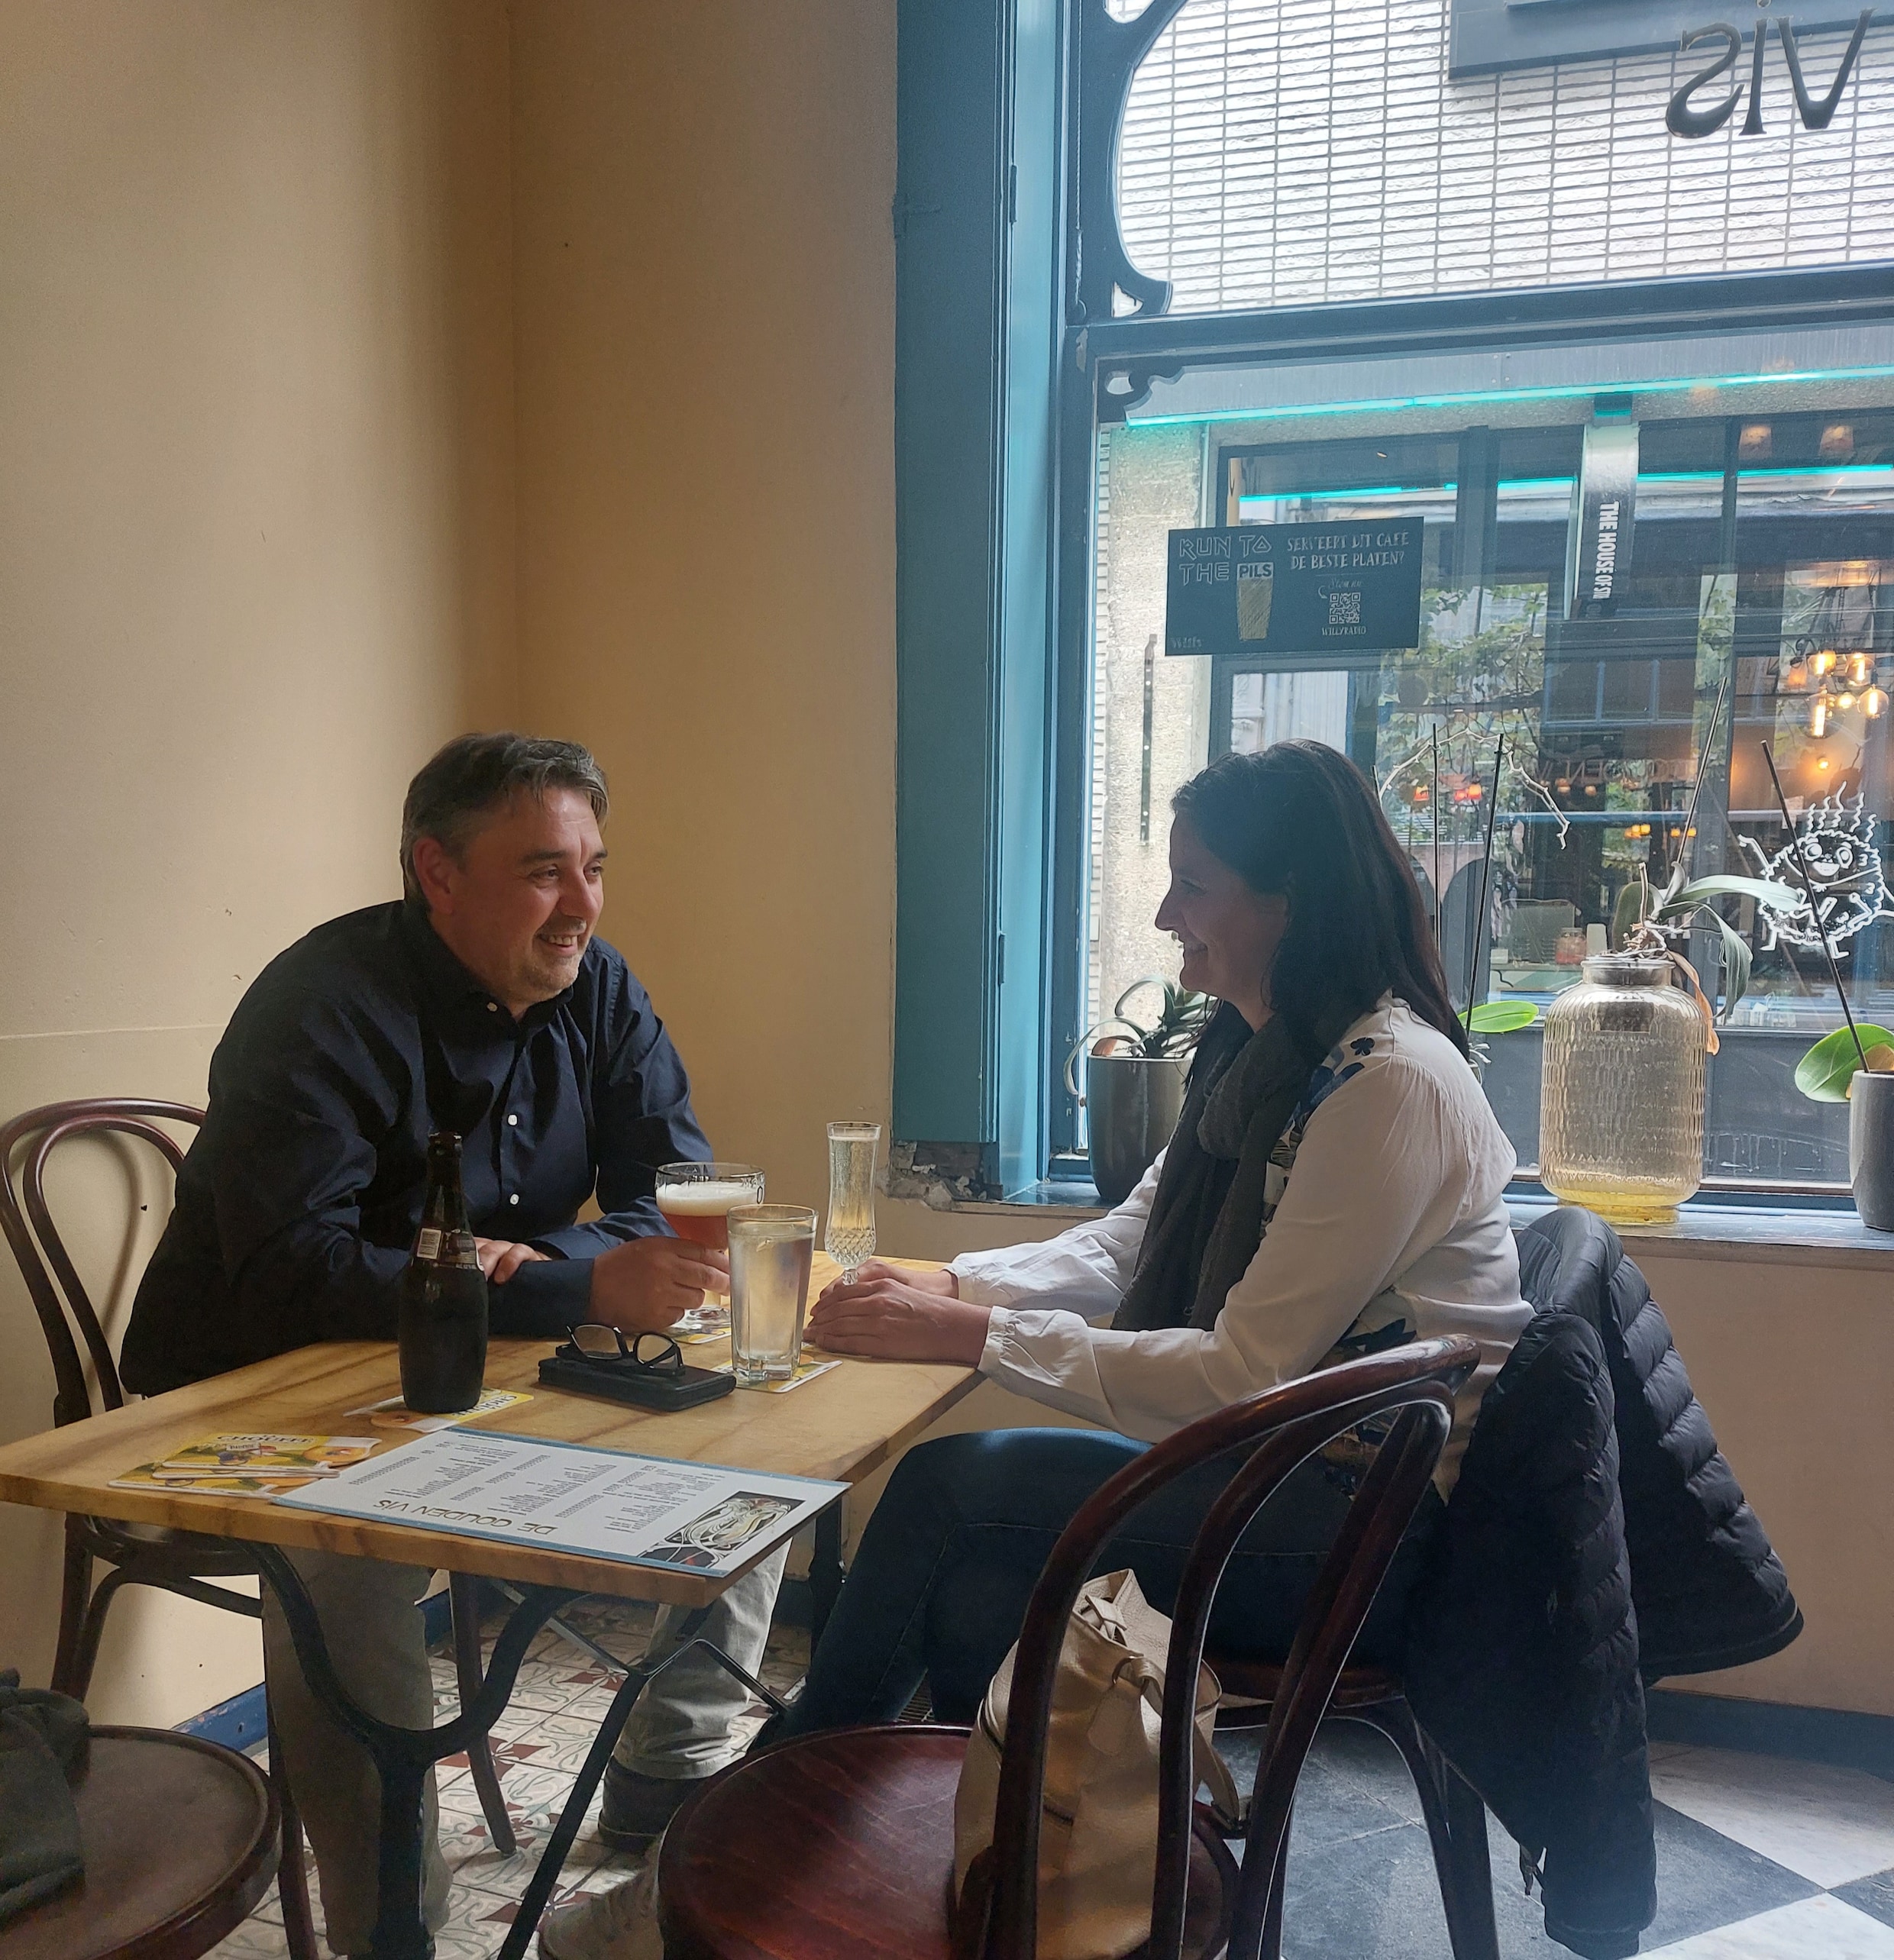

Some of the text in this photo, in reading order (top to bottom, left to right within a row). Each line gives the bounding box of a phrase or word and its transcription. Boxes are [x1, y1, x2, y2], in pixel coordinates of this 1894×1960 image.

[1598, 501, 1620, 531] THE
[1179, 534, 1272, 560] RUN TO
[1595, 531, 1618, 574] HOUSE
[1291, 551, 1404, 570] DE BESTE PLATEN?
[1179, 562, 1273, 586] THE PILS
[1594, 574, 1613, 587] OF
[411, 1506, 512, 1527] GOUDEN
[518, 1522, 558, 1535] DE
